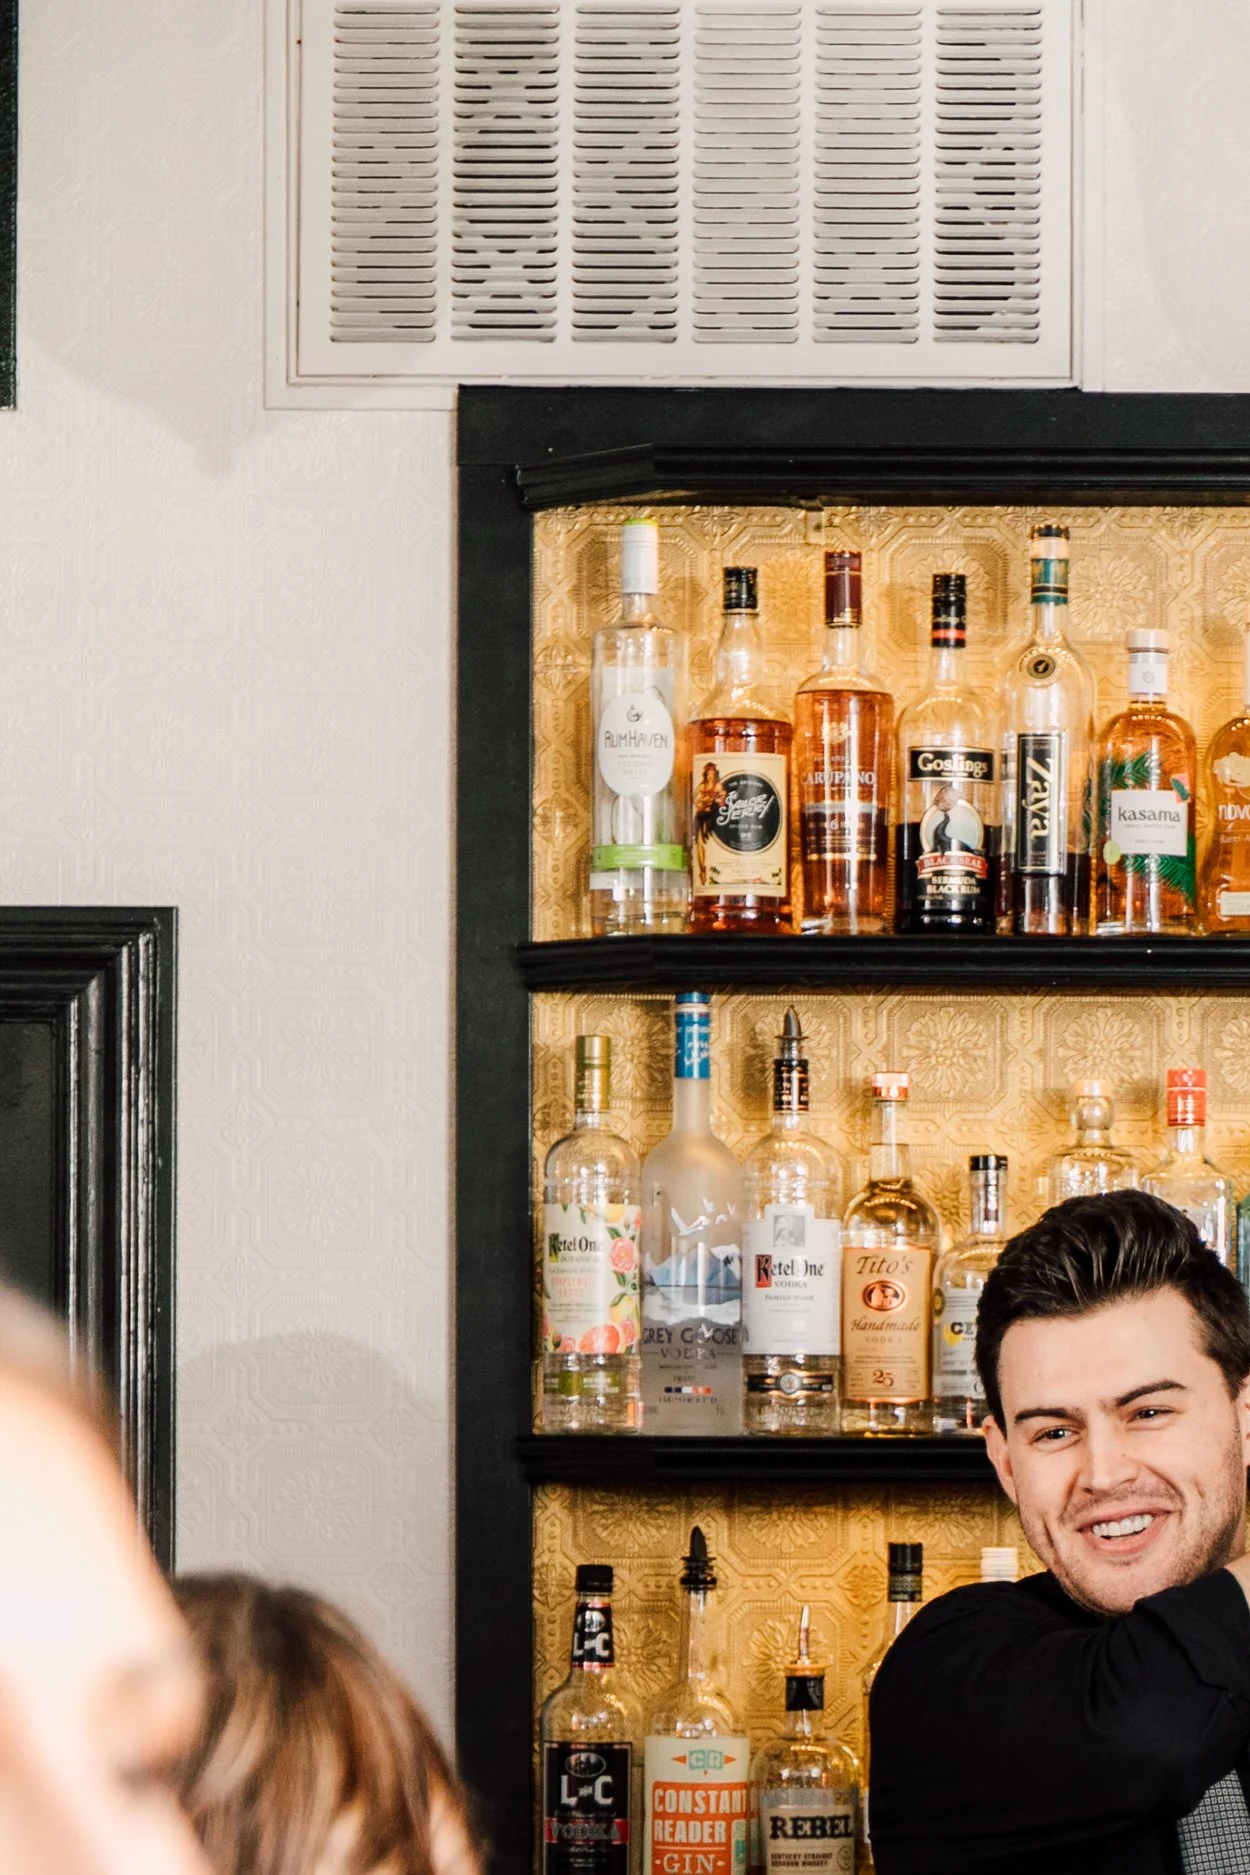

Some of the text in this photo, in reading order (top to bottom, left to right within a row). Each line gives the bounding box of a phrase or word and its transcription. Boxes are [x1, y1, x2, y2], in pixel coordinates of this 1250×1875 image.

[917, 752, 989, 778] Goslings
[1021, 756, 1058, 841] Zaya
[716, 795, 775, 826] JERRY
[1118, 806, 1181, 822] kasama
[926, 885, 980, 895] BLACK RUM
[931, 876, 977, 885] BERMUDA
[756, 1255, 795, 1283] Ketel
[857, 1254, 913, 1275] Tito's
[774, 1281, 808, 1289] VODKA
[850, 1316, 922, 1332] Handmade
[642, 1327, 738, 1346] GREY GOOSE
[865, 1335, 903, 1344] VODKA
[872, 1369, 895, 1388] 25
[654, 1788, 747, 1815] CONSTANT
[550, 1820, 620, 1840] VODKA
[654, 1819, 727, 1844] READER
[769, 1814, 853, 1840] REBEL
[662, 1853, 716, 1875] GIN
[770, 1851, 833, 1860] KENTUCKY STRAIGHT
[771, 1860, 829, 1868] BOURBON WHISKEY
